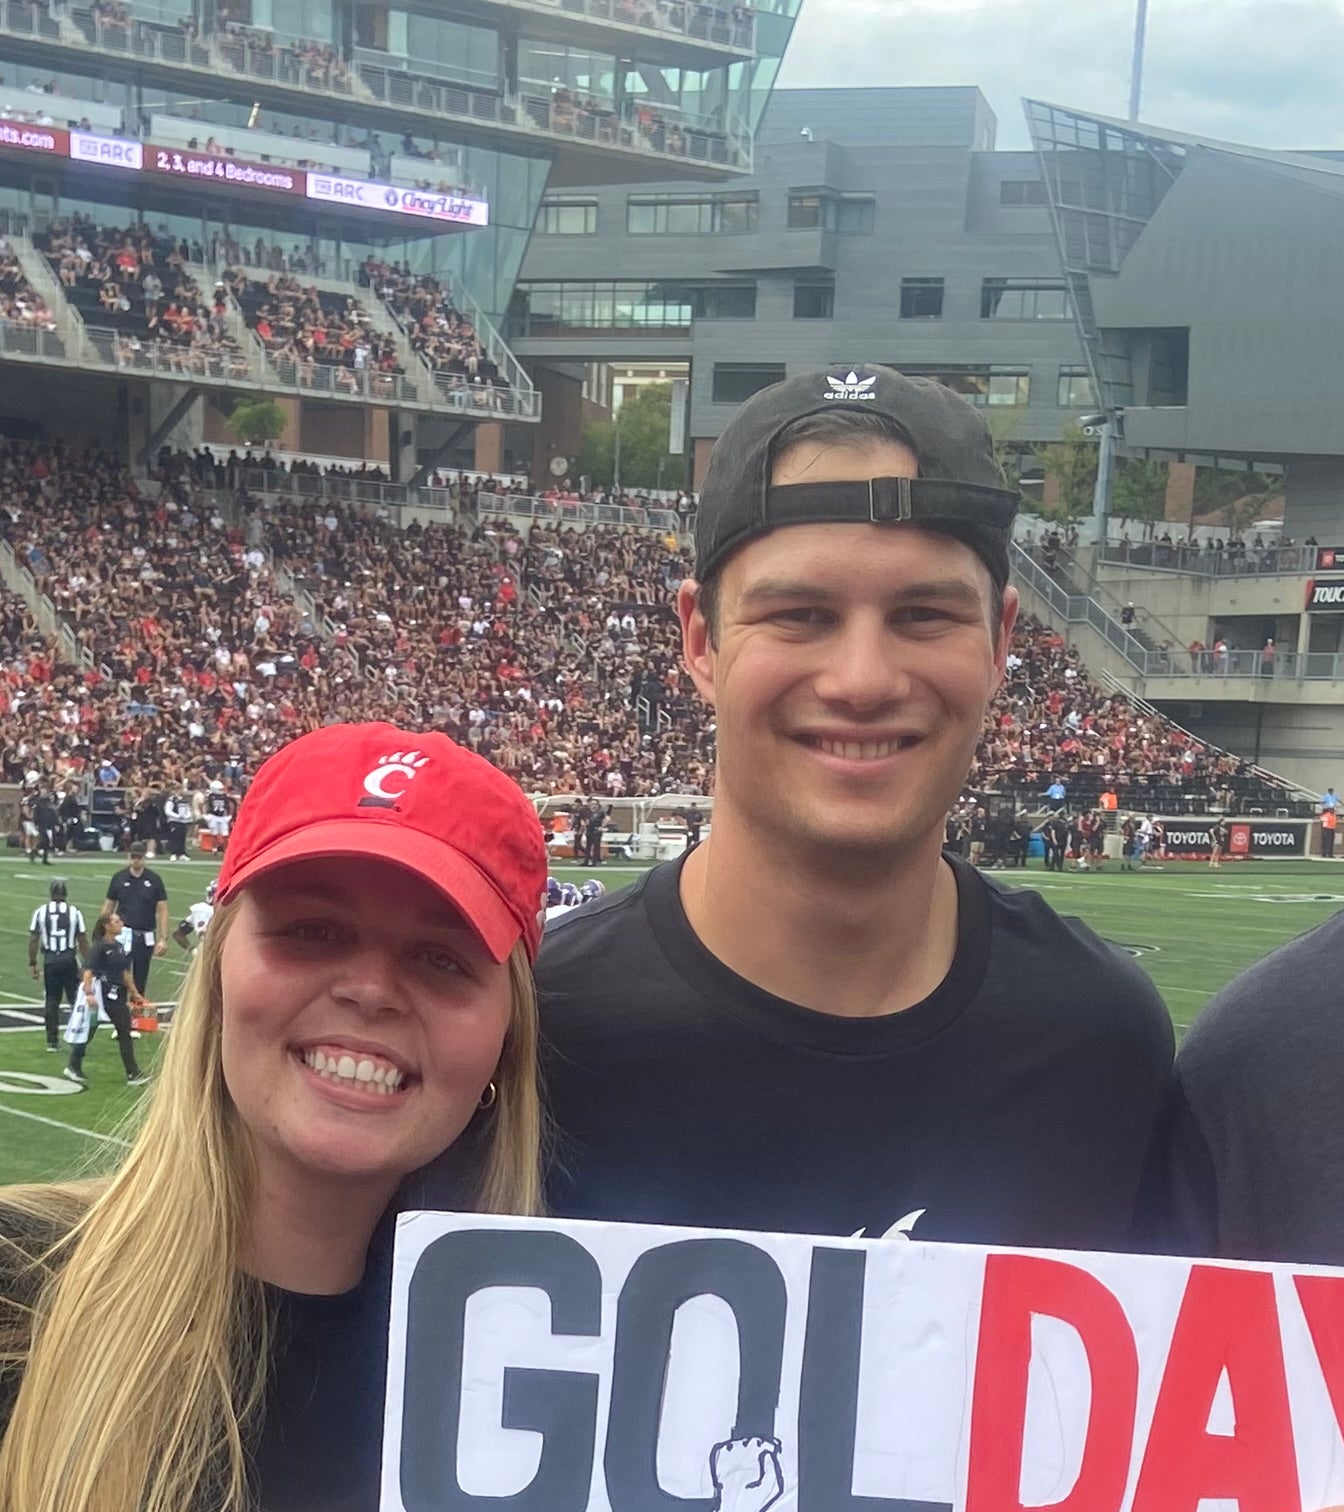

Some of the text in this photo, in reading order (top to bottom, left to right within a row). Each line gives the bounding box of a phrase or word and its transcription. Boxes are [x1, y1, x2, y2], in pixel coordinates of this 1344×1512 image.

[99, 143, 135, 163] ARC
[187, 160, 214, 176] and
[226, 163, 293, 189] Bedrooms
[333, 182, 364, 200] ARC
[823, 389, 876, 401] adidas
[1166, 831, 1295, 847] TOYOTA TOYOTA
[49, 914, 67, 937] L
